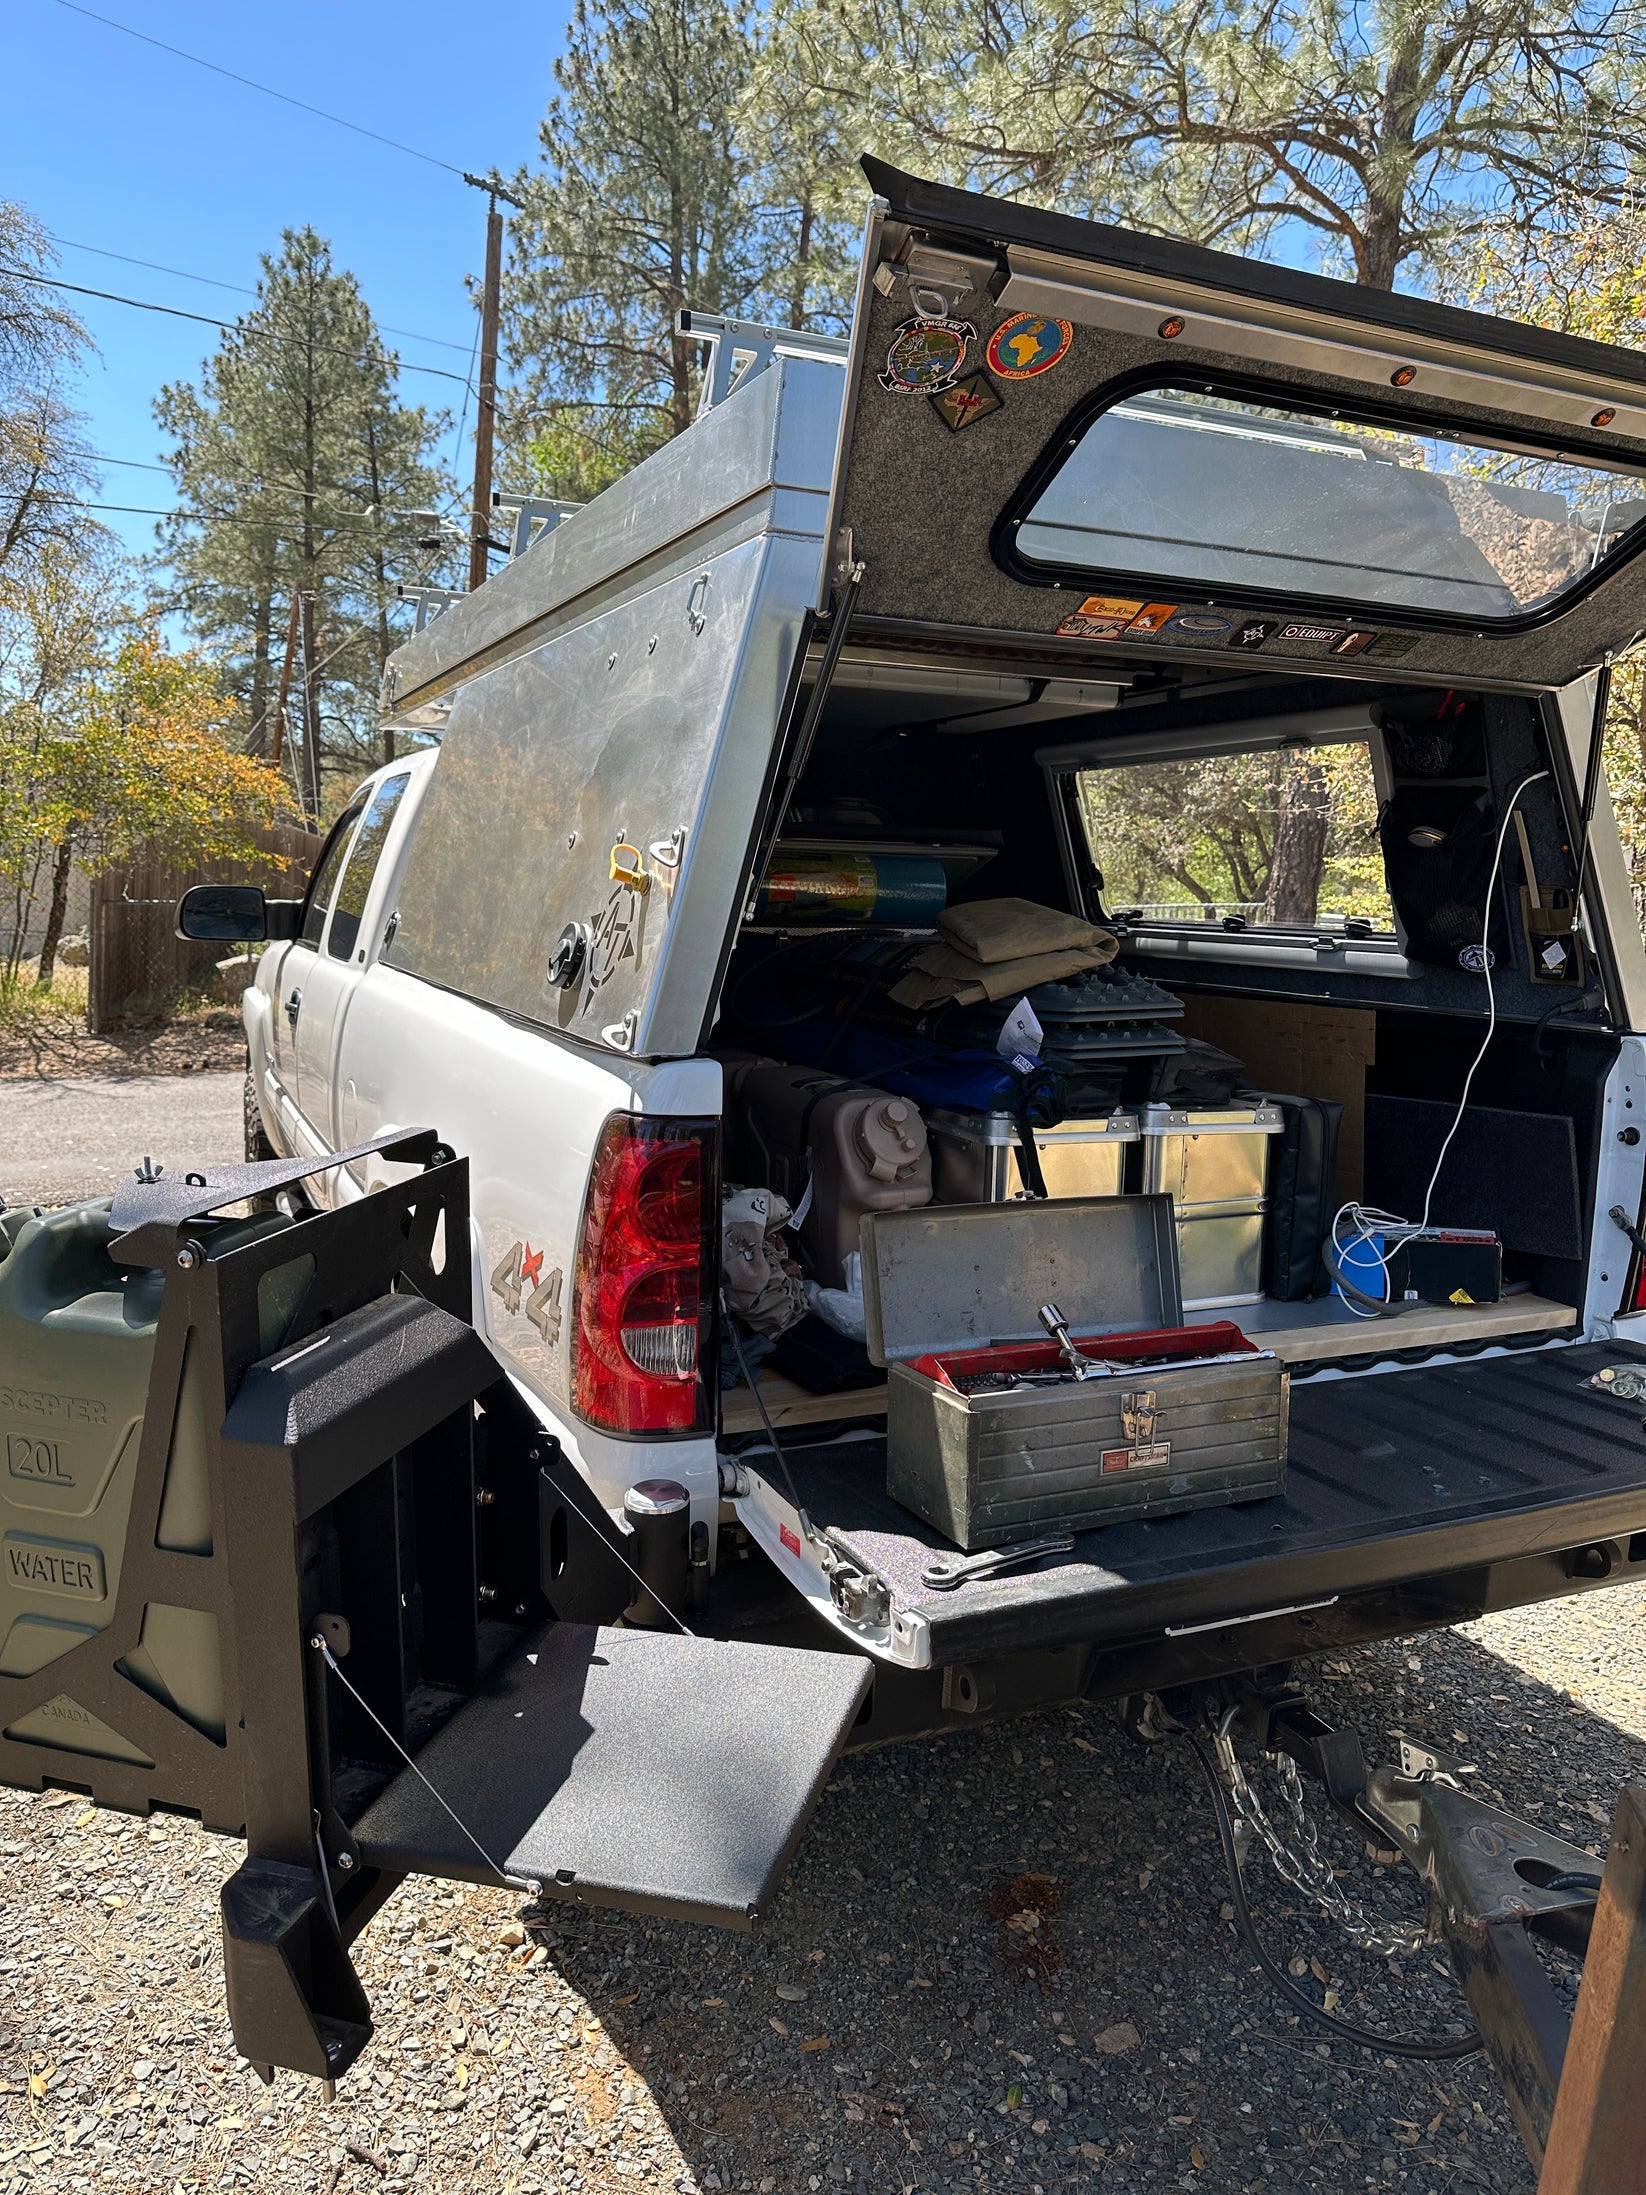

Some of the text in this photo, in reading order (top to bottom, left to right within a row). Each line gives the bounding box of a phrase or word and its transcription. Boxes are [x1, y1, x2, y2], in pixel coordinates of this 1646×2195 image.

[921, 320, 948, 328] VMGR
[1059, 320, 1071, 345] FORCES
[1003, 369, 1031, 377] AFRICA
[1298, 628, 1340, 640] EQUIPT
[15, 1437, 72, 1481] 20L
[9, 1548, 95, 1591] WATER
[41, 1704, 90, 1725] CANADA
